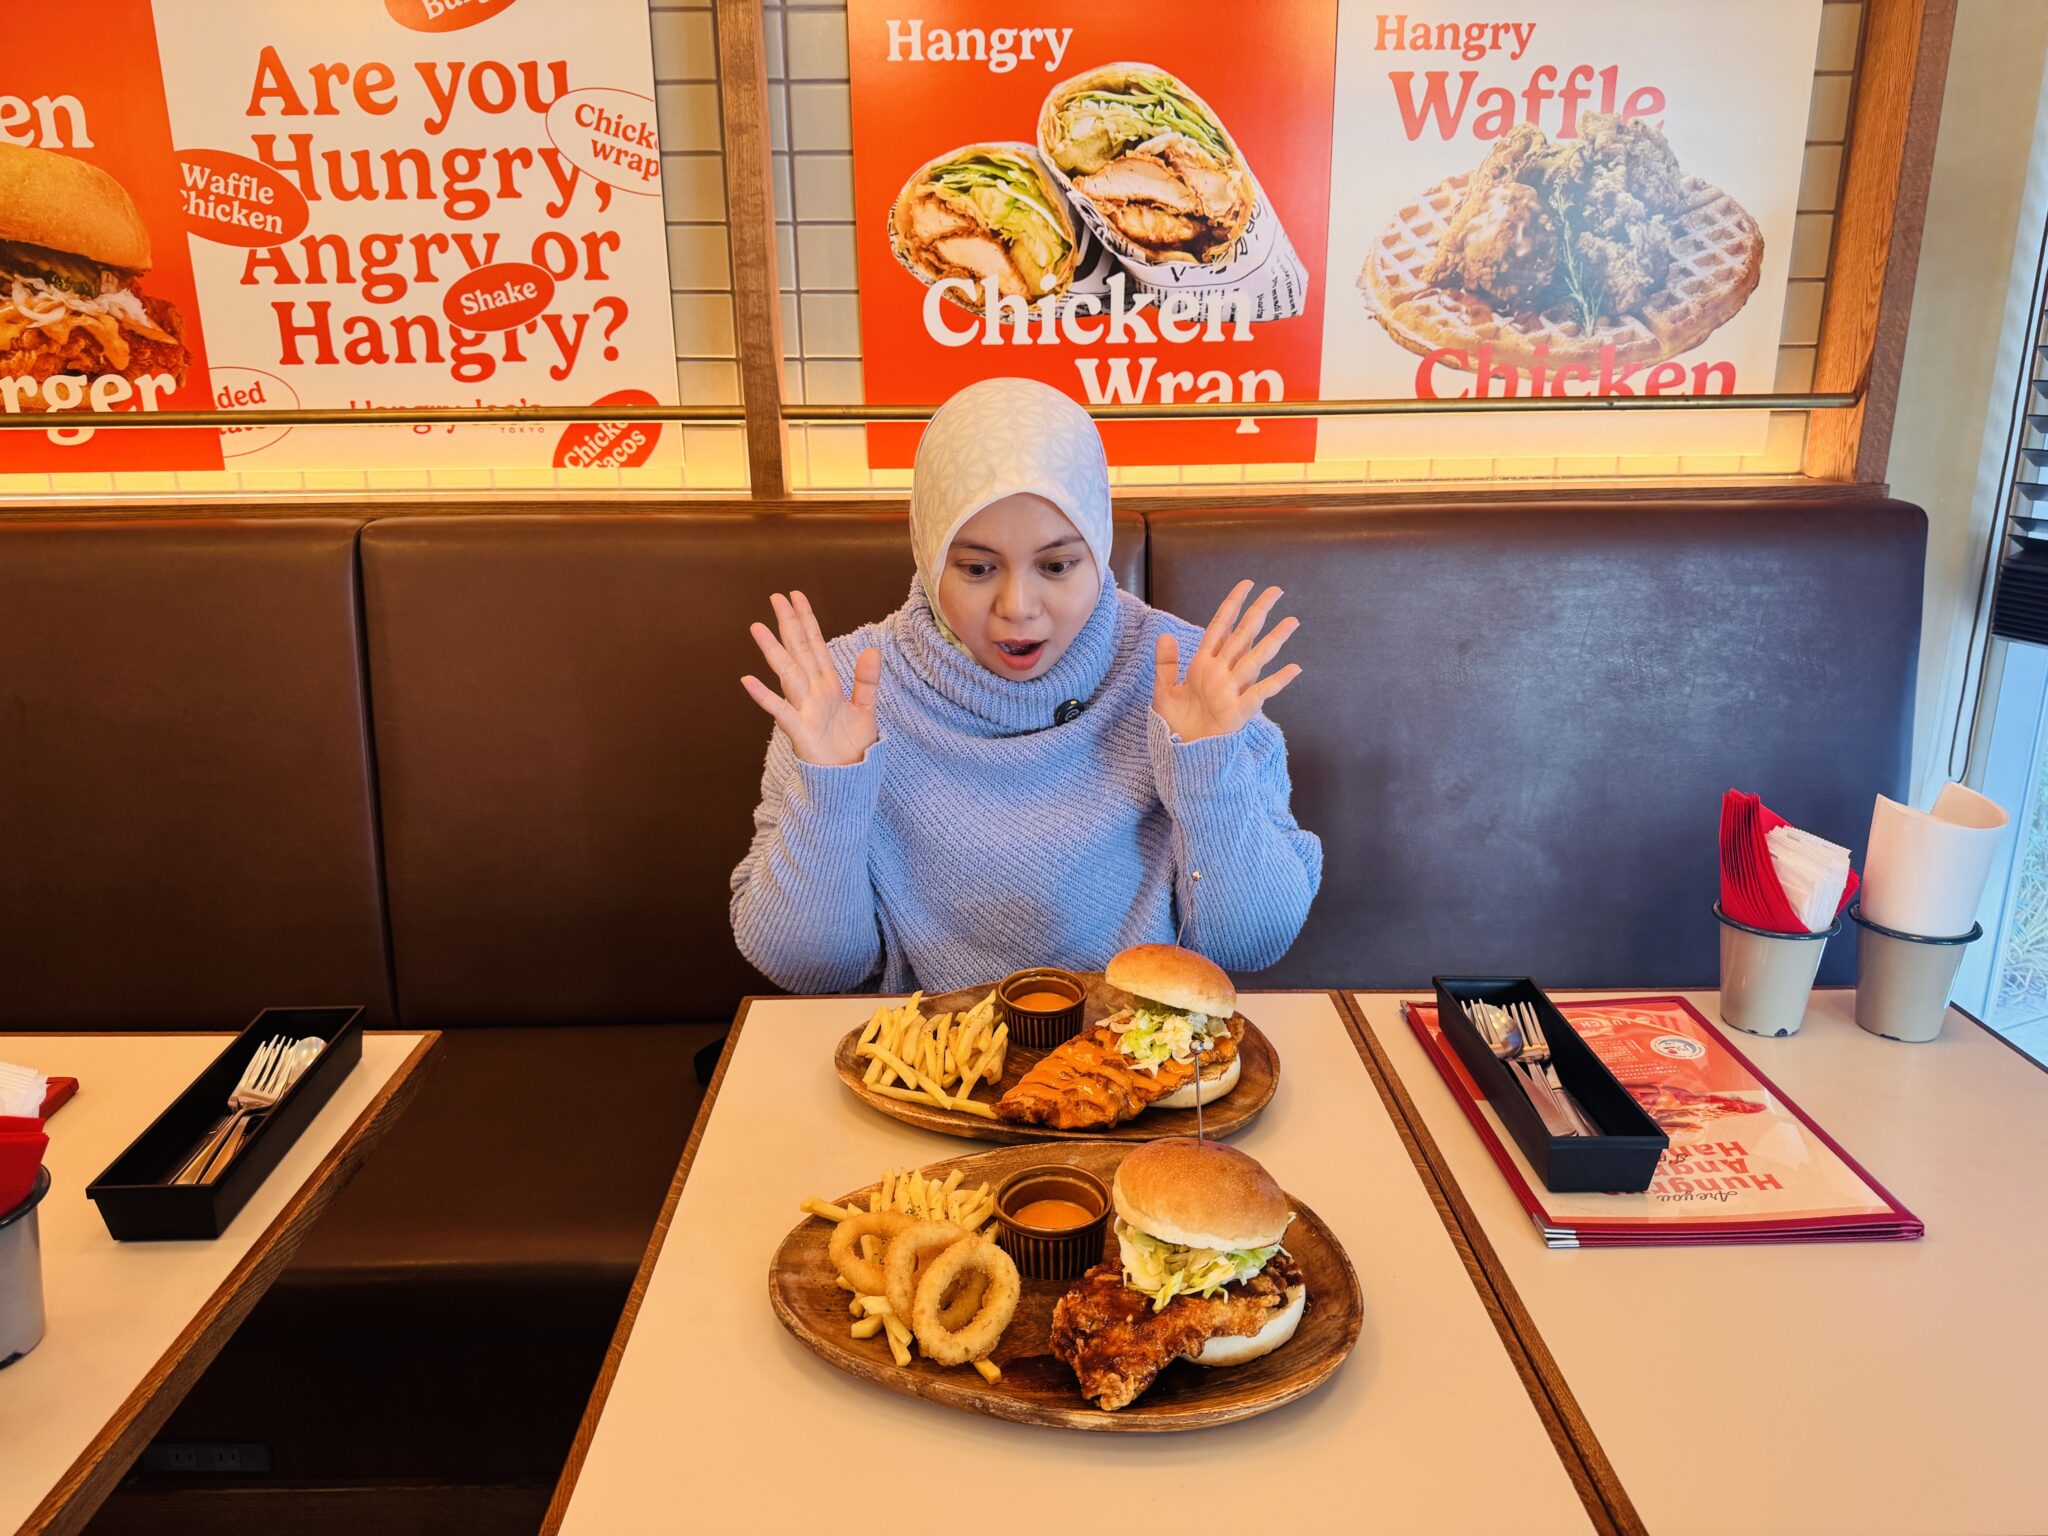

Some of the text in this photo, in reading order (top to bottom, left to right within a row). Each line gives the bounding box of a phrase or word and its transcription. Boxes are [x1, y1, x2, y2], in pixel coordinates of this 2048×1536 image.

[886, 19, 1073, 73] Hangry
[1374, 14, 1536, 61] Hangry
[246, 45, 568, 135] Are you
[1388, 64, 1666, 142] Waffle
[575, 103, 659, 150] Chick
[180, 162, 274, 205] Waffle
[252, 133, 612, 221] Hungry,
[591, 139, 660, 182] wrap
[180, 188, 283, 234] hicken
[240, 230, 621, 304] Angry or
[459, 282, 538, 316] Shake
[923, 274, 1255, 347] Chicken
[271, 296, 629, 383] Hangry?
[216, 380, 267, 408] ded
[1074, 357, 1285, 434] Wrap
[1415, 344, 1737, 400] Chicken
[501, 426, 545, 434] TOKYO
[563, 408, 633, 468] Chick
[1654, 1157, 1749, 1178] Angr
[1662, 1141, 1748, 1157] Han
[1644, 1173, 1784, 1195] Hungr
[1656, 1190, 1738, 1202] Are you
